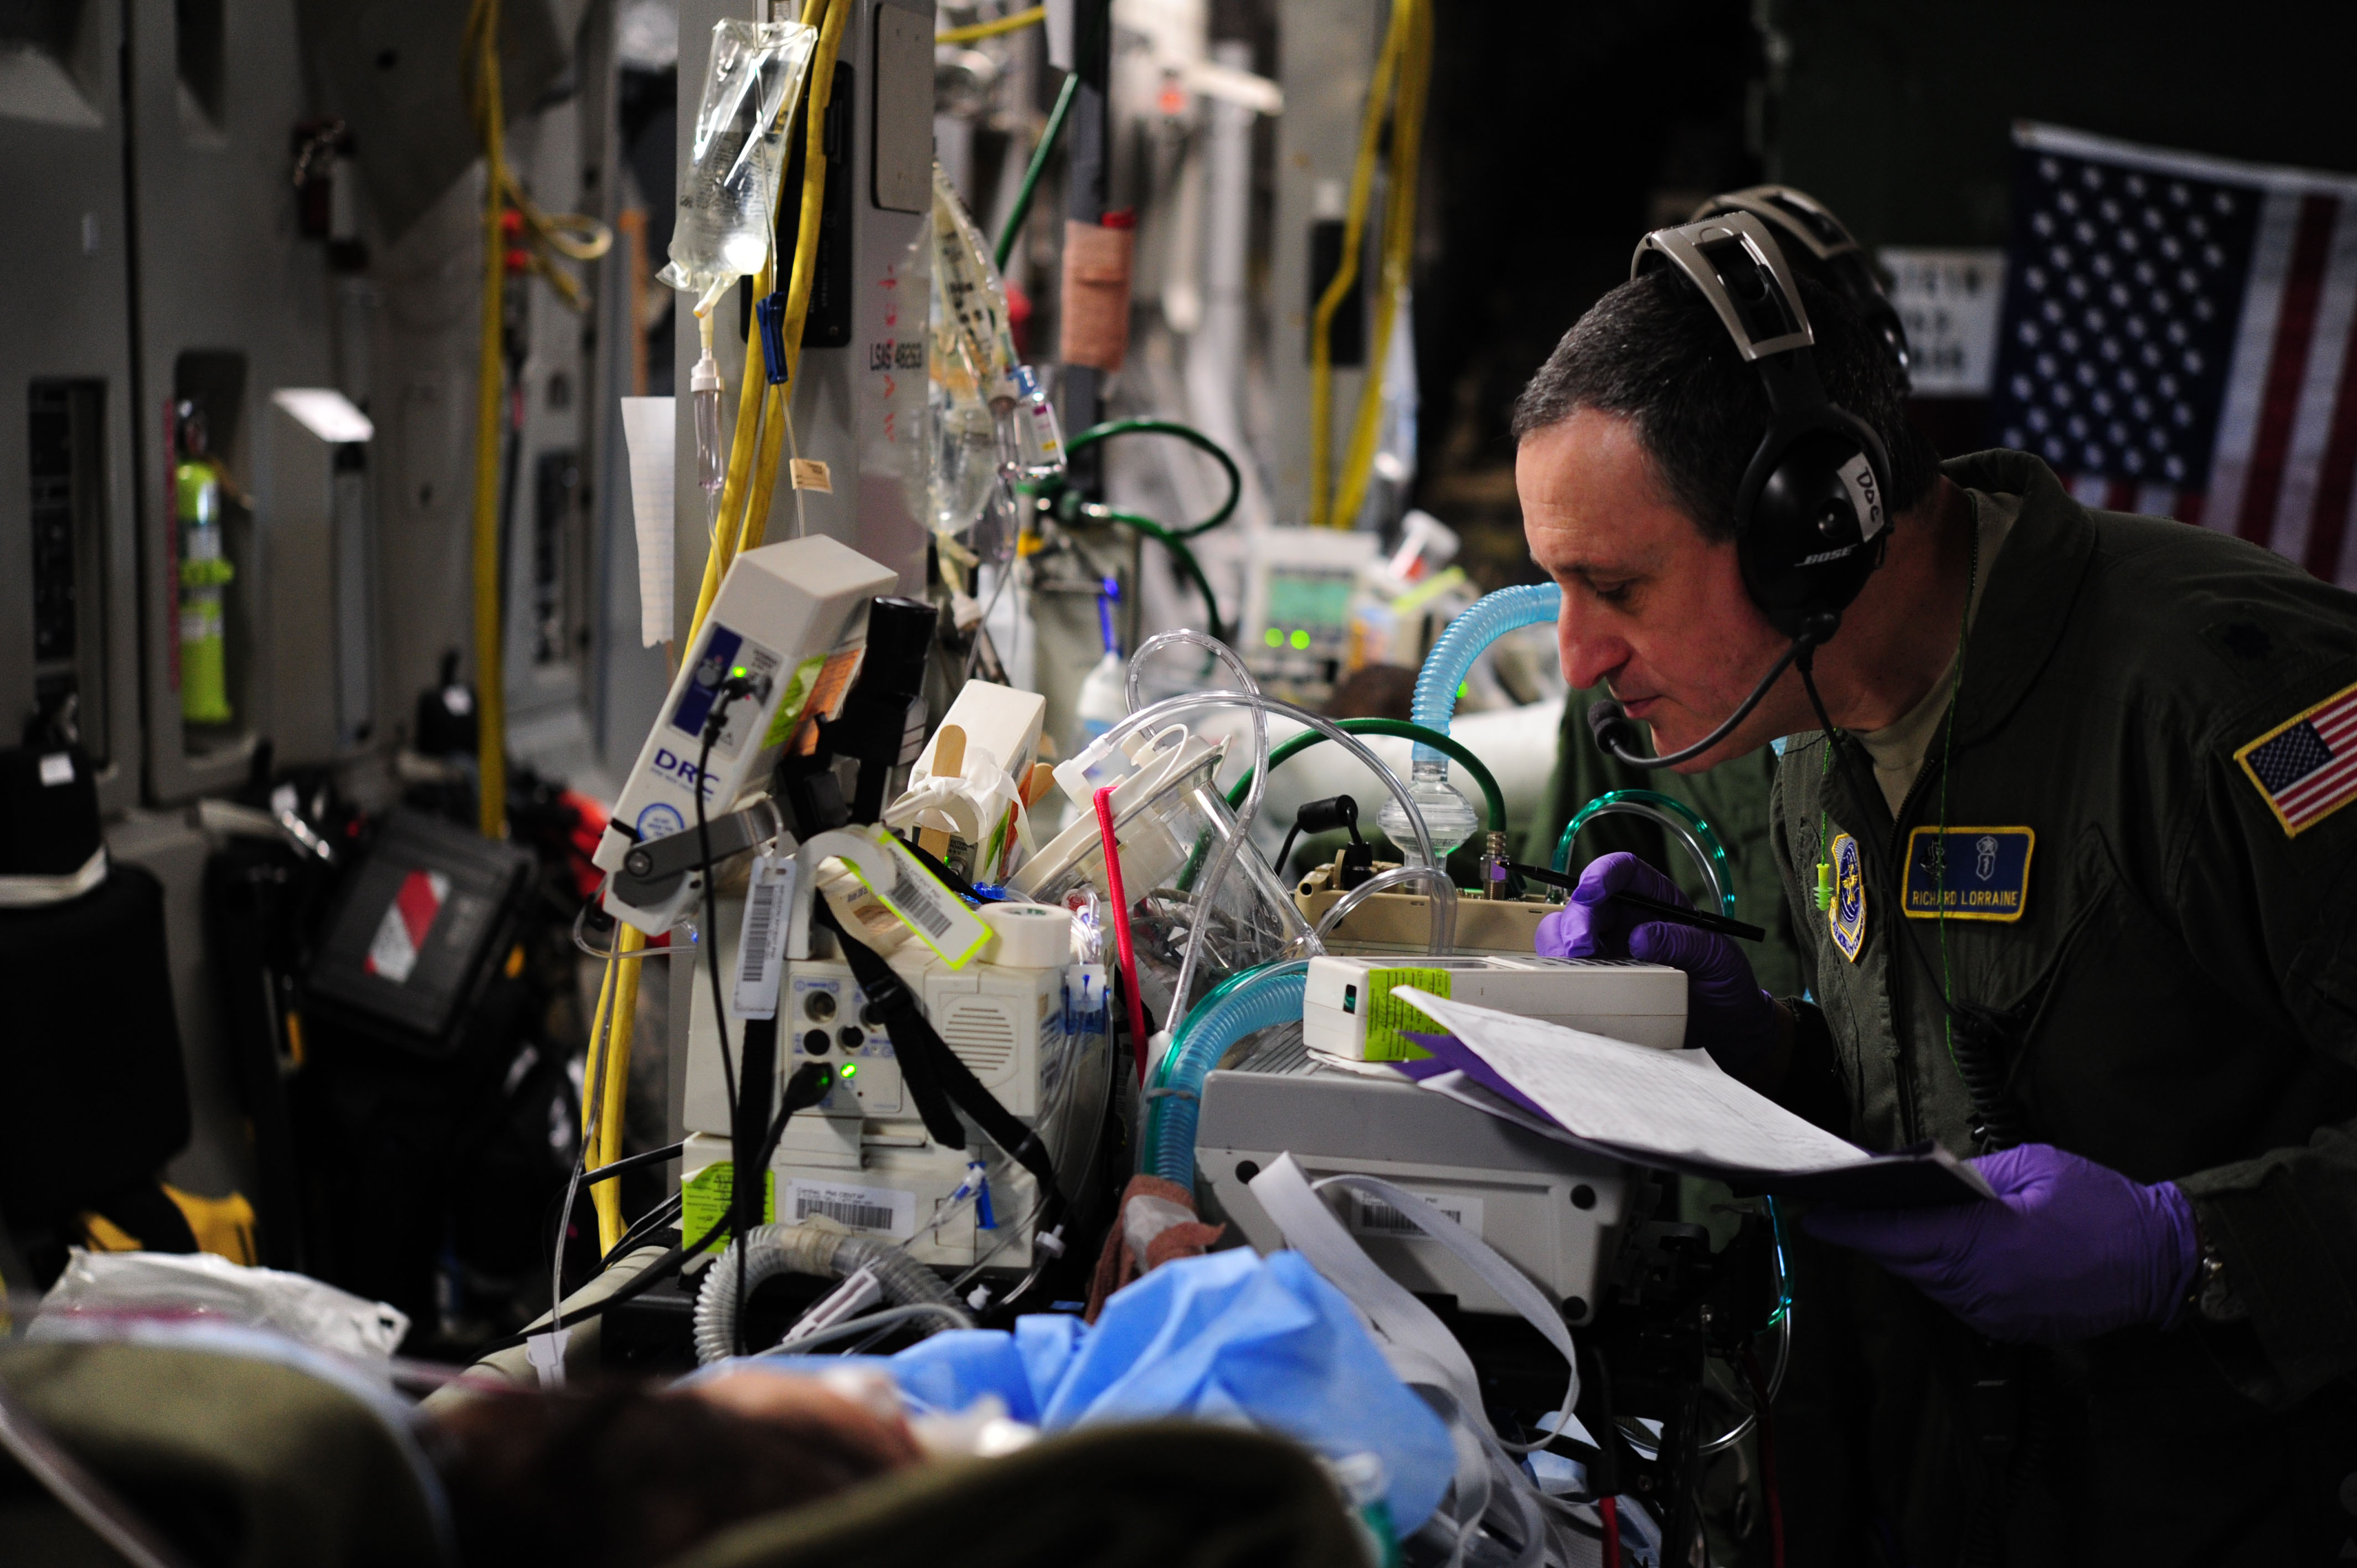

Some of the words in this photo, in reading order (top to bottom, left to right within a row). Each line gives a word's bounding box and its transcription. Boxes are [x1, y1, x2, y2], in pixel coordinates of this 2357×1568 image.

[1801, 545, 1855, 565] BOSE
[653, 747, 721, 795] DRC
[1960, 891, 2019, 906] LORRAINE
